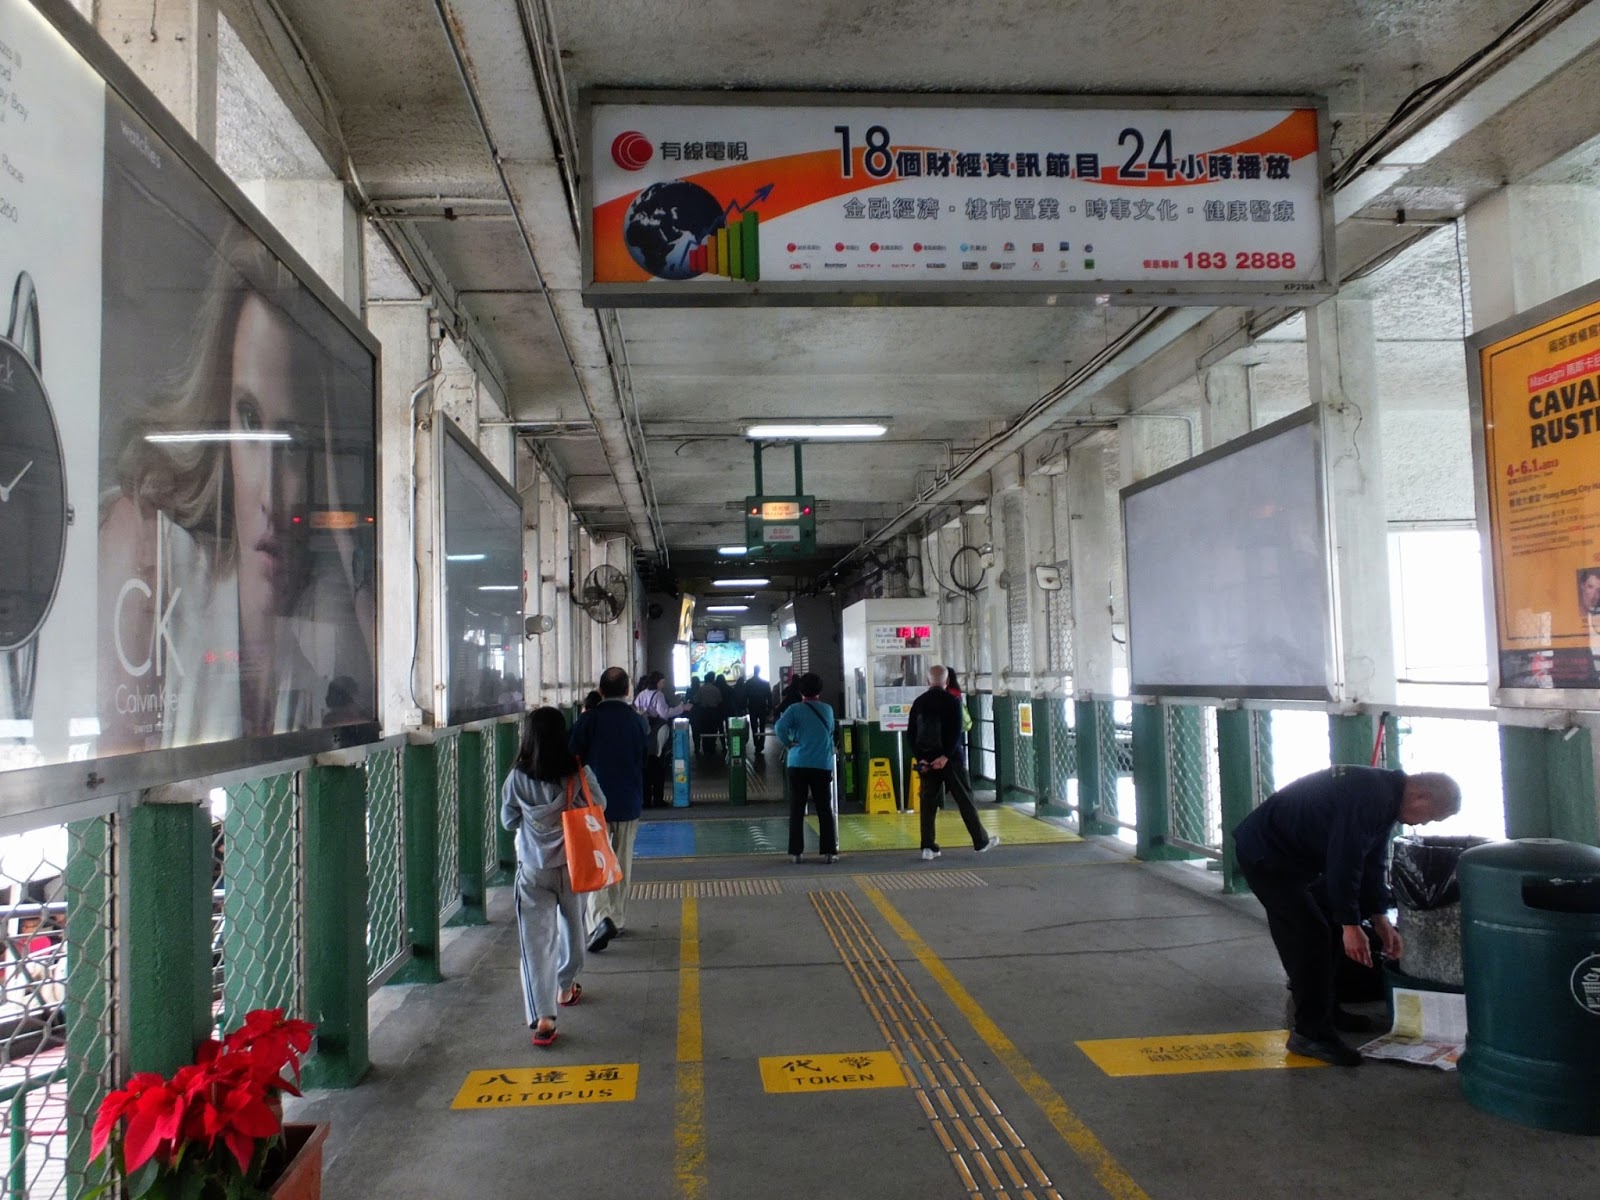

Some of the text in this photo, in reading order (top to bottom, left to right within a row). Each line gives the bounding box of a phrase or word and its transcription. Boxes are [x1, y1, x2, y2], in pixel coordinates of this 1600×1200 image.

[660, 141, 748, 160] 有線電視
[1184, 252, 1226, 269] 183
[1236, 252, 1296, 269] 2888
[1529, 374, 1600, 420] CAVA
[116, 684, 158, 714] Calvin
[479, 1067, 625, 1086] 八達通
[792, 1073, 875, 1085] TOKEN
[476, 1088, 613, 1104] OCTOPUS
